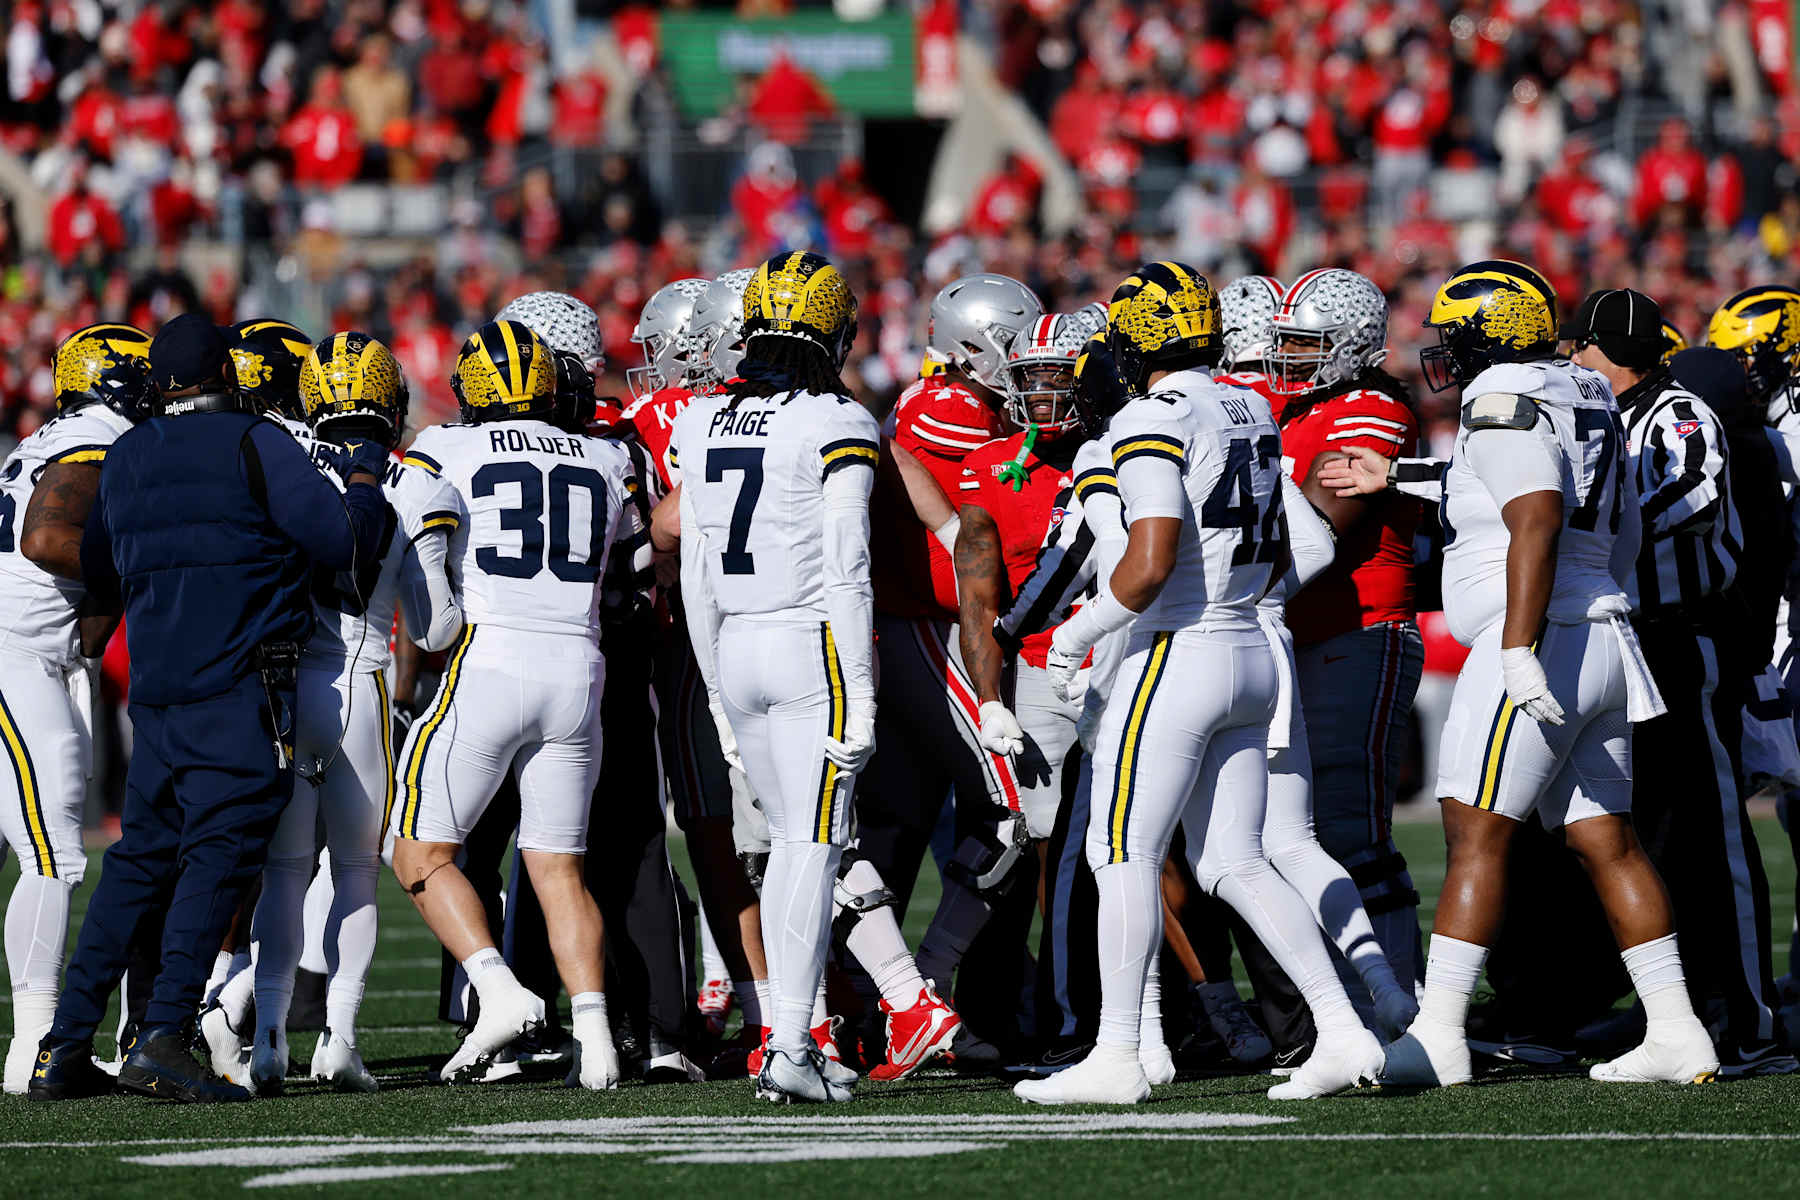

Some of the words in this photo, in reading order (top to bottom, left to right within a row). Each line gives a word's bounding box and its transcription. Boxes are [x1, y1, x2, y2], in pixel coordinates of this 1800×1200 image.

[1167, 327, 1178, 337] 42
[164, 400, 195, 416] meijer
[1221, 397, 1256, 425] GUY
[708, 410, 776, 438] PAIGE
[489, 429, 585, 458] ROLDER
[705, 447, 766, 575] 7
[1201, 434, 1284, 567] 42
[471, 460, 608, 584] 30
